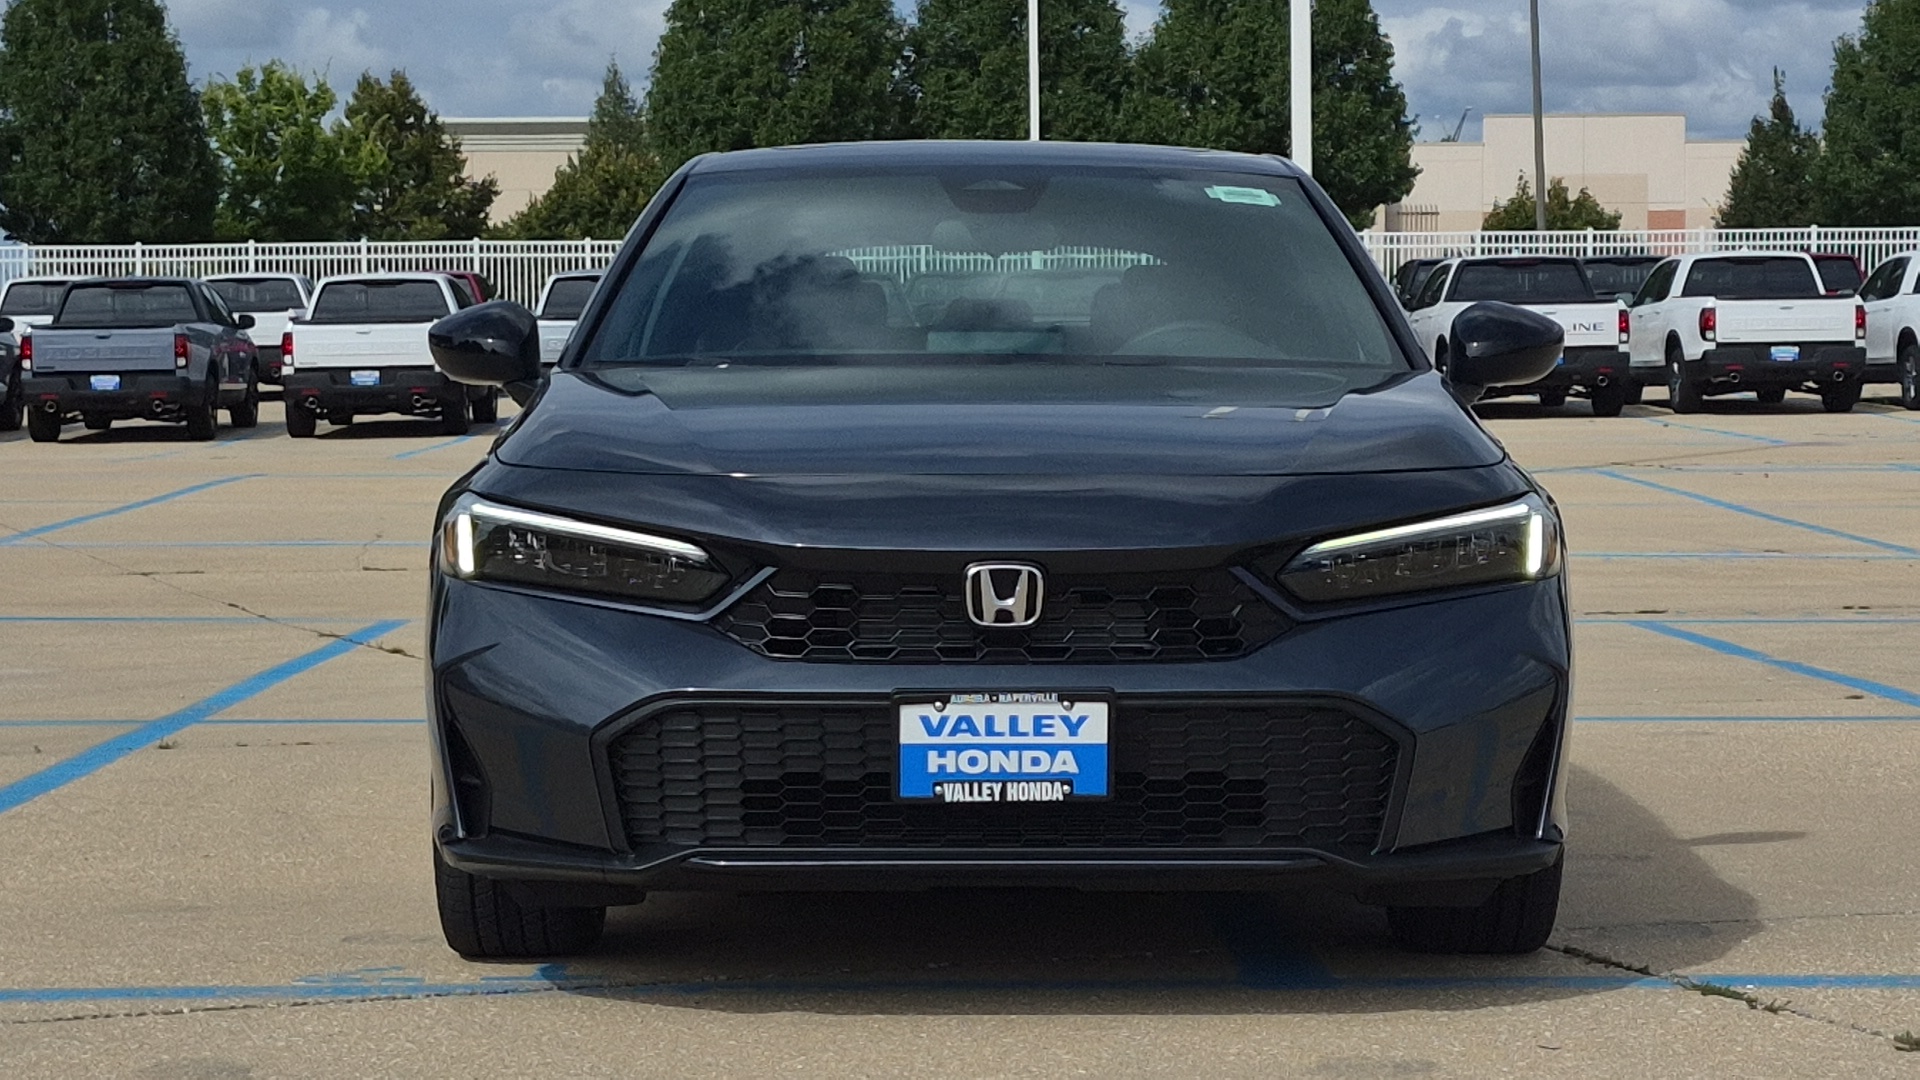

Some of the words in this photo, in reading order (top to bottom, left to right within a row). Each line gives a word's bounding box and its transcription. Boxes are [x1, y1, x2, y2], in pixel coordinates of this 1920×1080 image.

[1566, 322, 1605, 332] INE
[919, 714, 1090, 737] VALLEY
[927, 750, 1080, 775] HONDA
[943, 781, 1003, 802] VALLEY
[1006, 781, 1064, 801] HONDA
